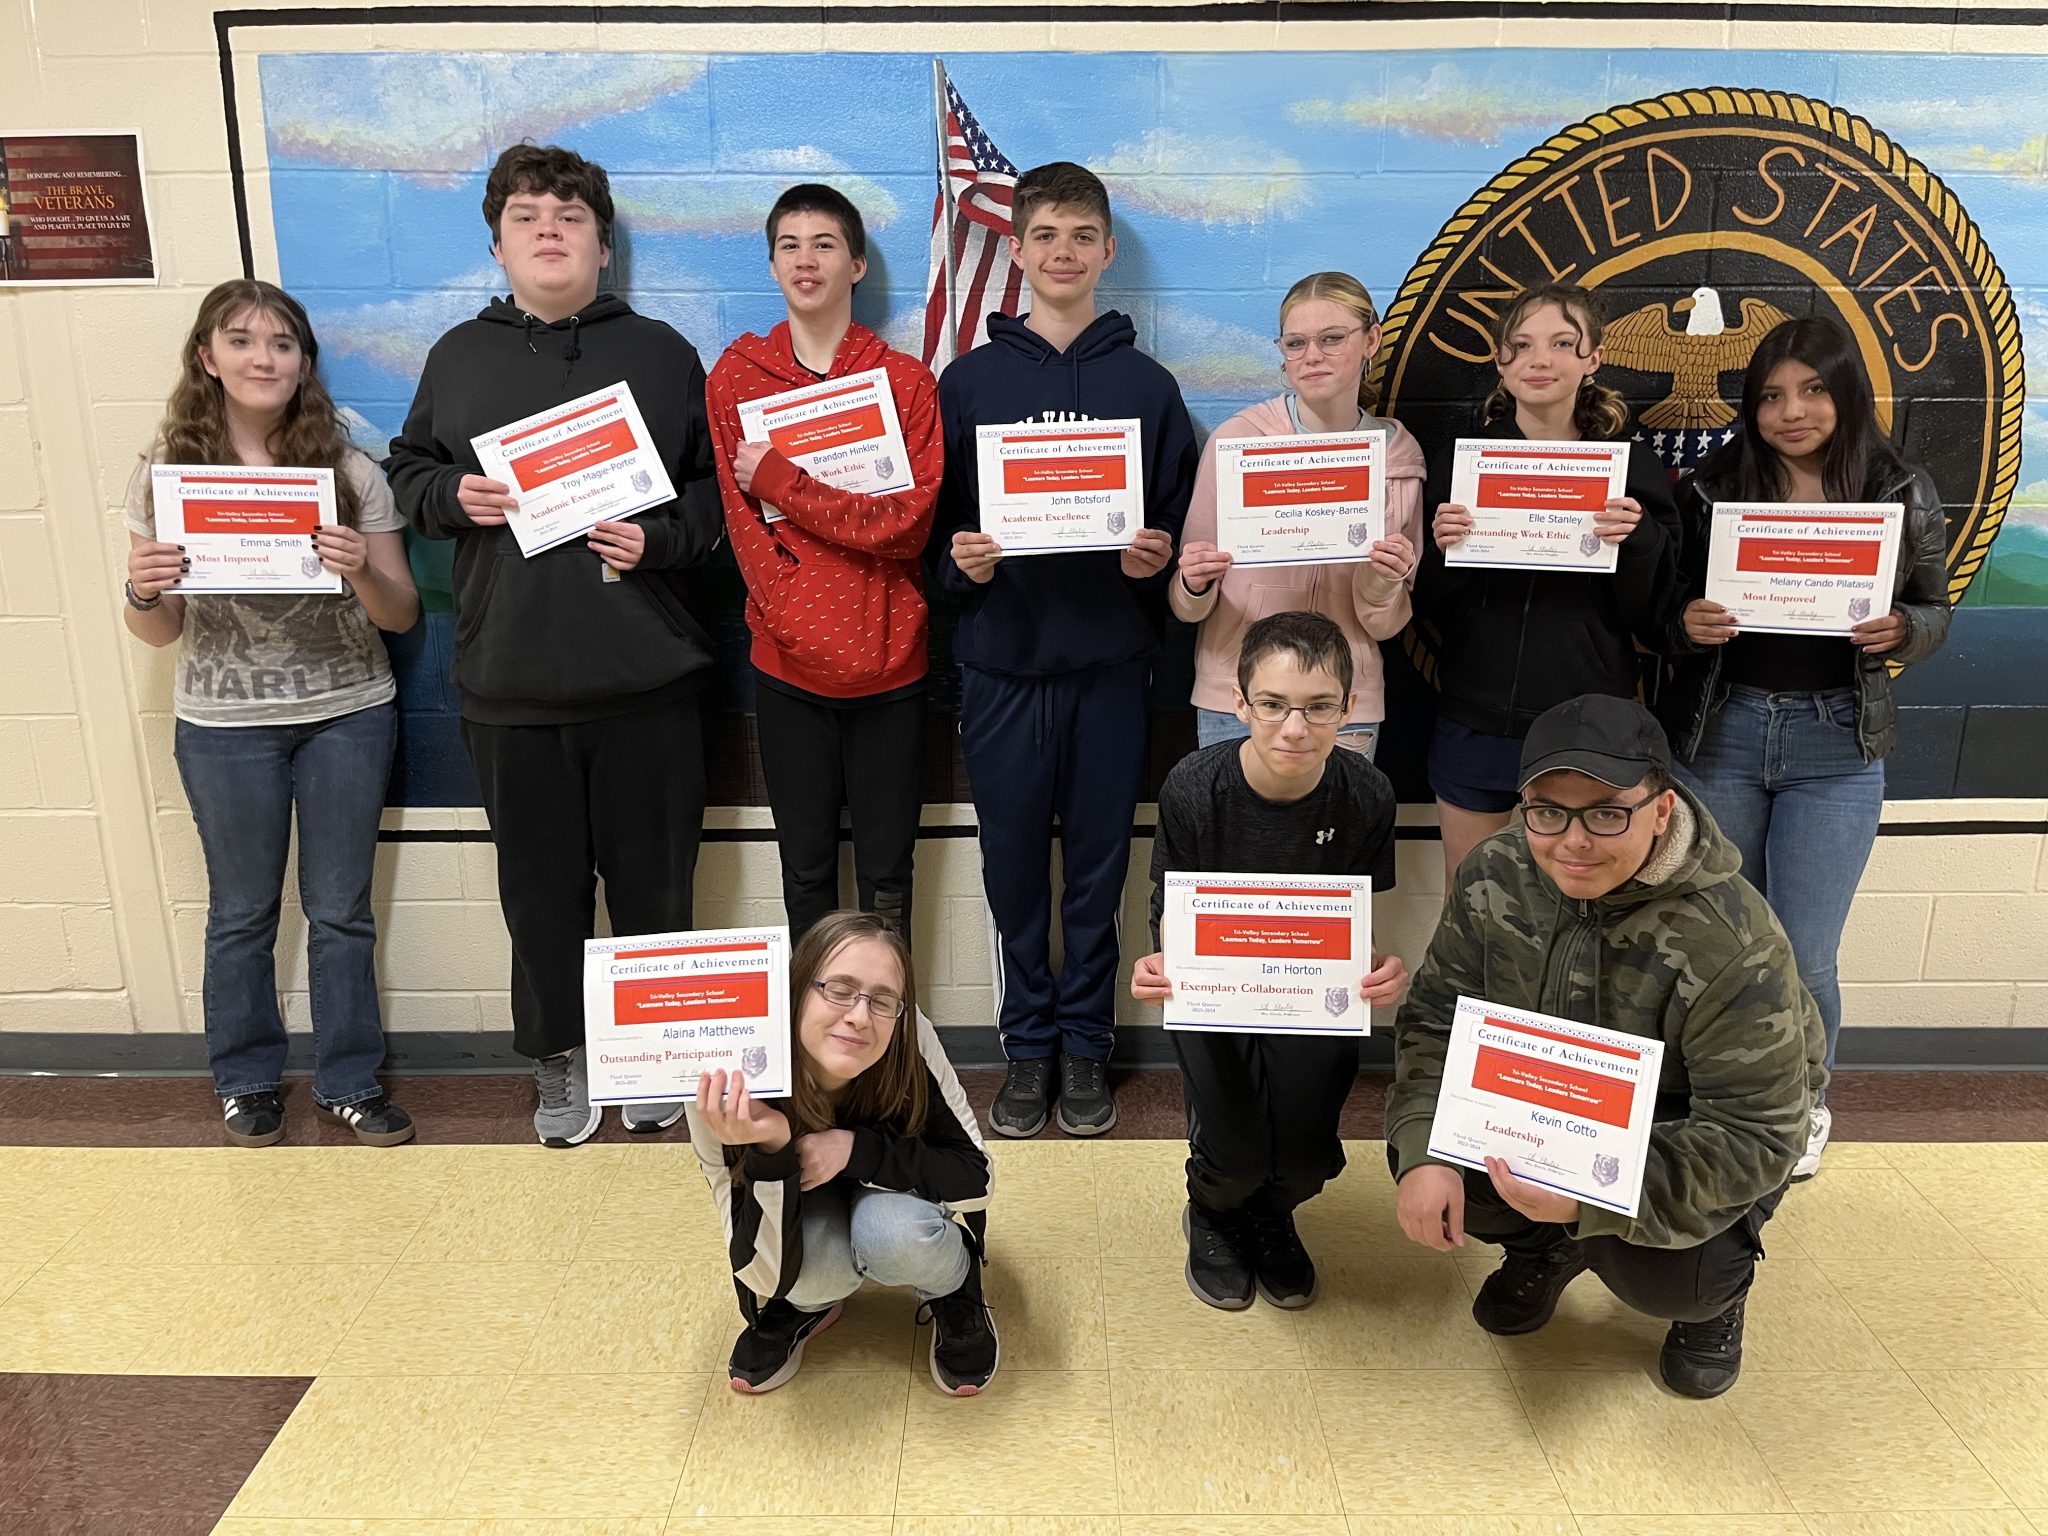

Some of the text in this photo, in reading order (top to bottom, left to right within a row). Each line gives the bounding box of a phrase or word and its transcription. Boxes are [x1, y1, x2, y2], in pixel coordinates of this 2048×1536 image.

[46, 185, 105, 195] THE BRAVE
[34, 195, 114, 210] VETERANS
[1428, 146, 1968, 372] UNITED STATES
[763, 410, 806, 426] Certificate
[822, 393, 878, 410] Achievement
[502, 435, 550, 458] Certificate
[553, 430, 563, 439] of
[566, 408, 623, 434] Achievement
[797, 430, 816, 439] Tri-Valley
[816, 425, 837, 434] Secondary
[813, 443, 879, 465] Brandon Hinkley
[1000, 446, 1048, 454] Certificate
[1240, 459, 1290, 468] Certificate
[1308, 455, 1370, 464] Achievement
[1477, 461, 1611, 472] Certificate of Achievement
[561, 477, 581, 490] Troy
[583, 456, 636, 481] Magie-Porter
[820, 468, 842, 479] Work
[845, 463, 865, 472] Ethic
[178, 487, 234, 495] Certificate
[254, 488, 319, 497] Achievement
[530, 500, 570, 520] Academic
[571, 483, 616, 504] Excellence
[1051, 495, 1110, 505] John Botsford
[1001, 514, 1043, 523] Academic
[1275, 506, 1368, 518] Cecilia Koskey-Barnes
[1529, 514, 1582, 526] Elle Stanley
[1261, 526, 1309, 536] Leadership
[1521, 530, 1544, 539] Work
[1547, 532, 1571, 540] Ethic
[1738, 525, 1793, 534] Certificate
[1813, 527, 1883, 536] Achievement
[275, 539, 302, 547] Smith
[224, 555, 269, 564] Improved
[1770, 578, 1802, 587] Melany
[1804, 579, 1833, 587] Cando
[1837, 579, 1873, 589] Pilatasig
[1769, 594, 1816, 604] Improved
[1192, 899, 1352, 912] Certificate of Achievement
[610, 958, 769, 975] Certificate of Achievement
[1262, 964, 1322, 975] Ian Horton
[1180, 982, 1313, 994] Exemplary Collaboration
[663, 1024, 754, 1040] Alaina Matthews
[600, 1048, 732, 1064] Outstanding Participation
[1478, 1028, 1638, 1076] Certificate of Achievement
[1512, 1069, 1588, 1092] Tri-Valley Secondary School
[1531, 1110, 1597, 1138] Kevin Cotto
[1484, 1120, 1544, 1147] Leadership
